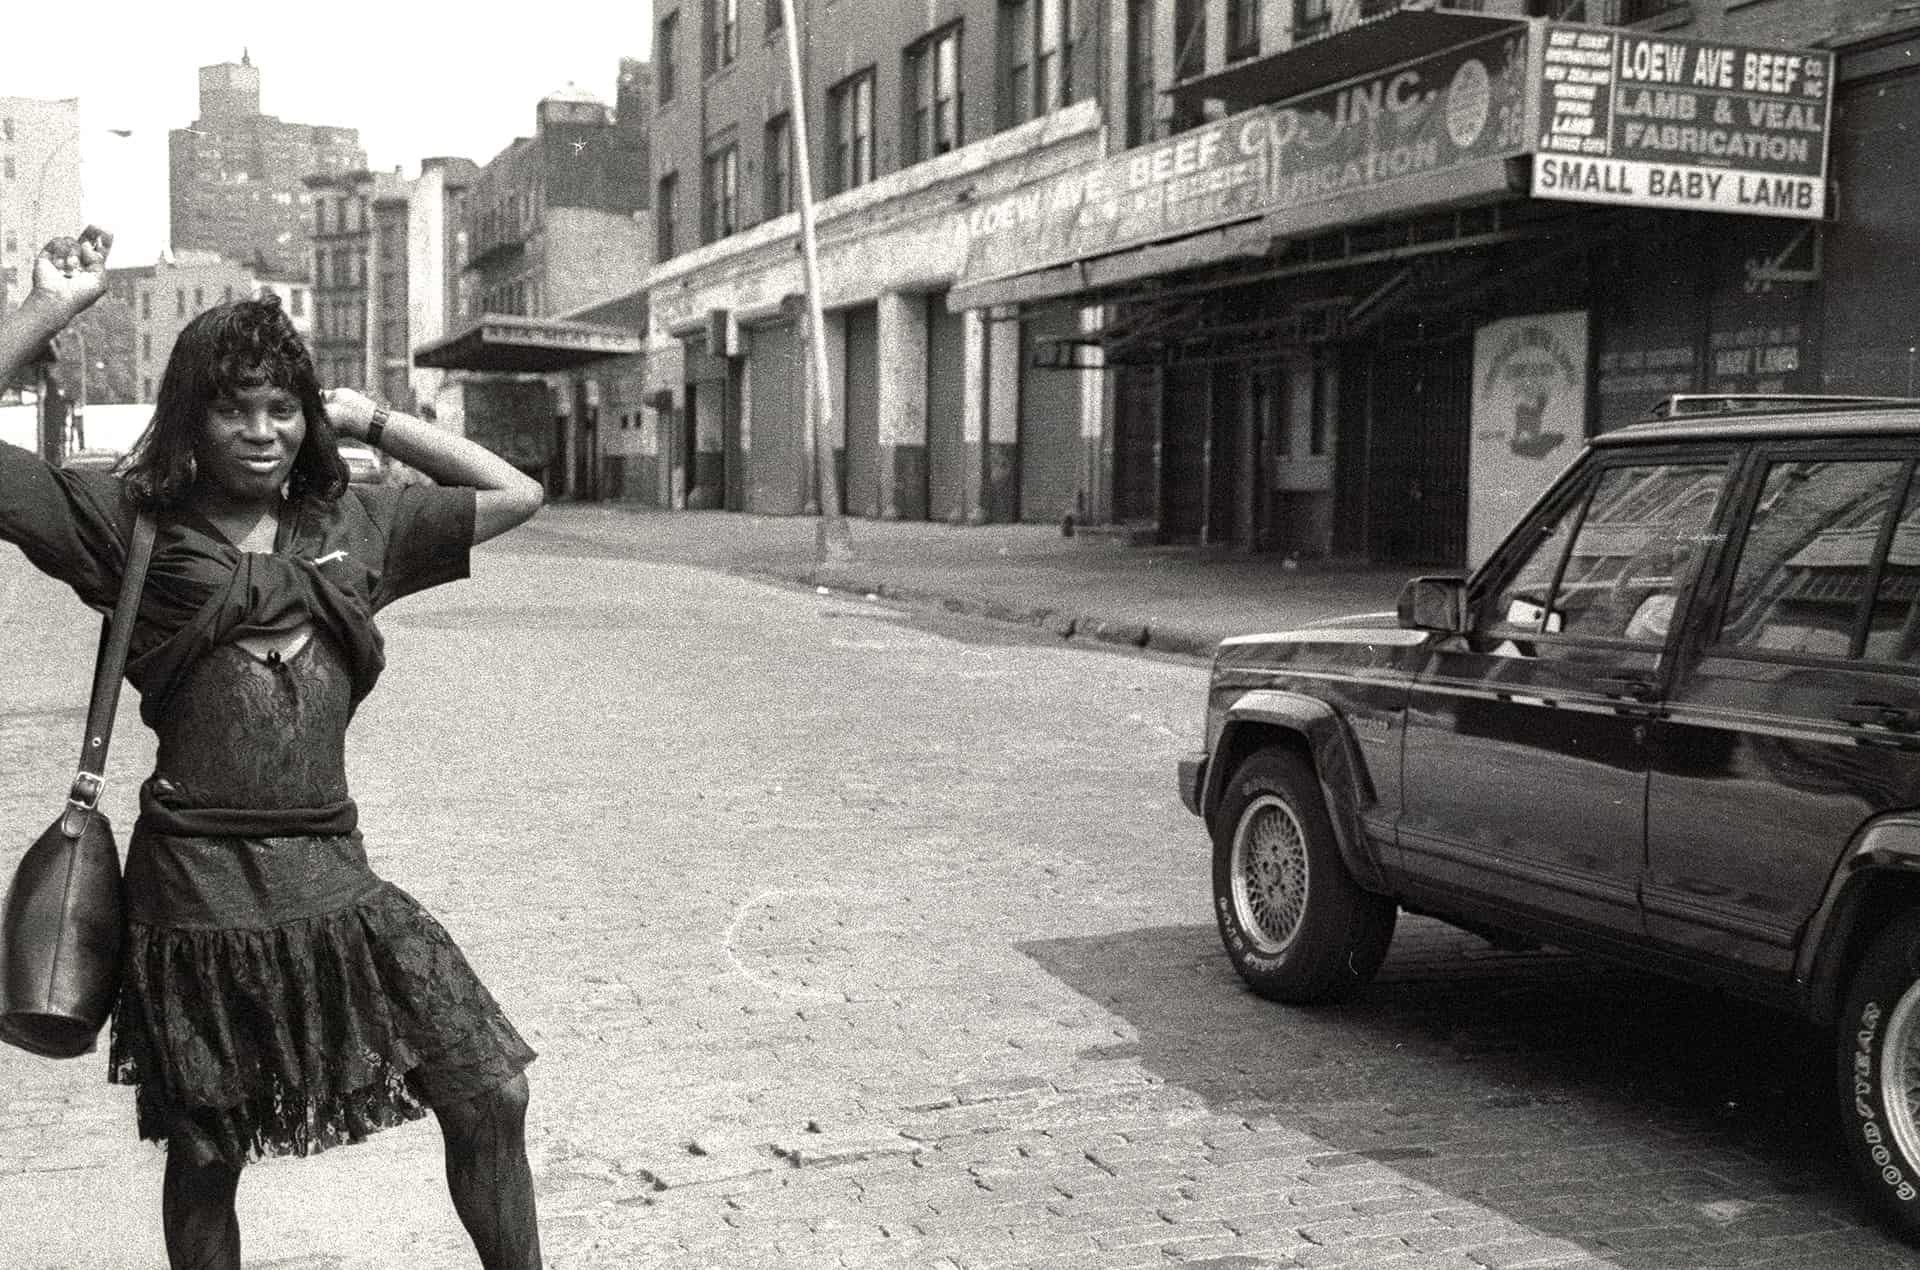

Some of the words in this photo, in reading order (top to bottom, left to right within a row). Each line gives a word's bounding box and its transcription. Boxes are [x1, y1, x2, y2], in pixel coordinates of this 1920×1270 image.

[1621, 40, 1686, 82] LOEW
[1693, 49, 1734, 88] AVE
[1743, 52, 1801, 94] BEEF
[1615, 88, 1698, 120] LAMB
[1714, 99, 1735, 124] &
[1748, 101, 1822, 132] VEAL
[1129, 130, 1223, 187] BEEF
[1625, 122, 1808, 162] FABRICATION
[1541, 160, 1633, 194] SMALL
[1649, 170, 1725, 202] BABY
[1739, 176, 1813, 210] LAMB
